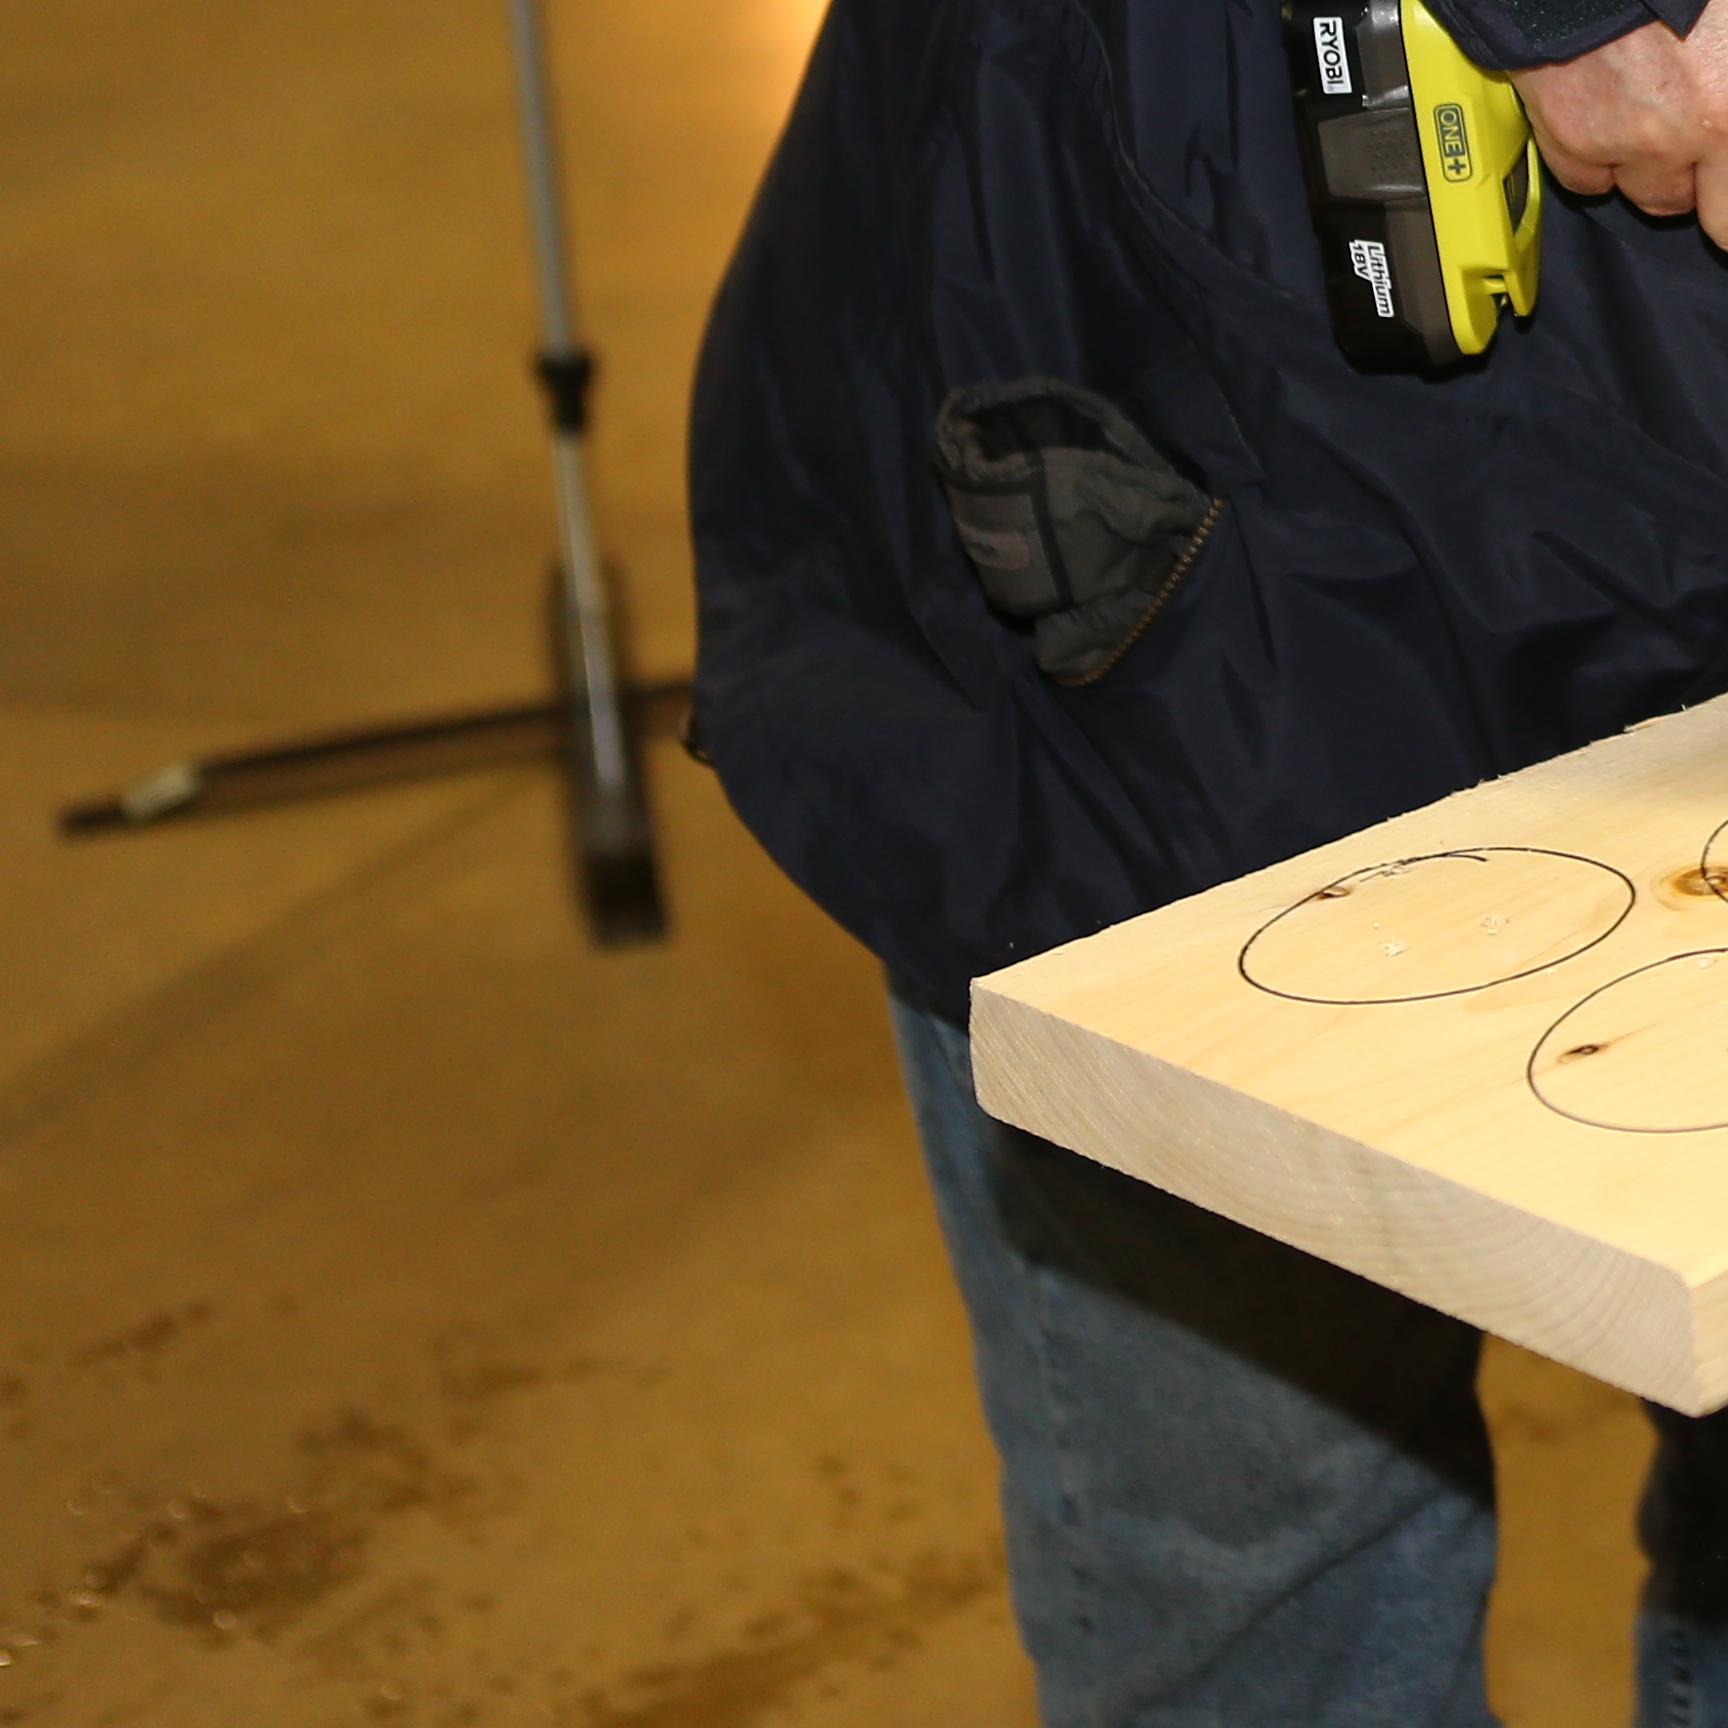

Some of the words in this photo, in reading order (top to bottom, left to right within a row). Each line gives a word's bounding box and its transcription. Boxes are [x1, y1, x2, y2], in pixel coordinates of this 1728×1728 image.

[1319, 20, 1344, 86] RYOBI
[1353, 243, 1370, 278] 18V
[1367, 244, 1391, 314] Lithium
